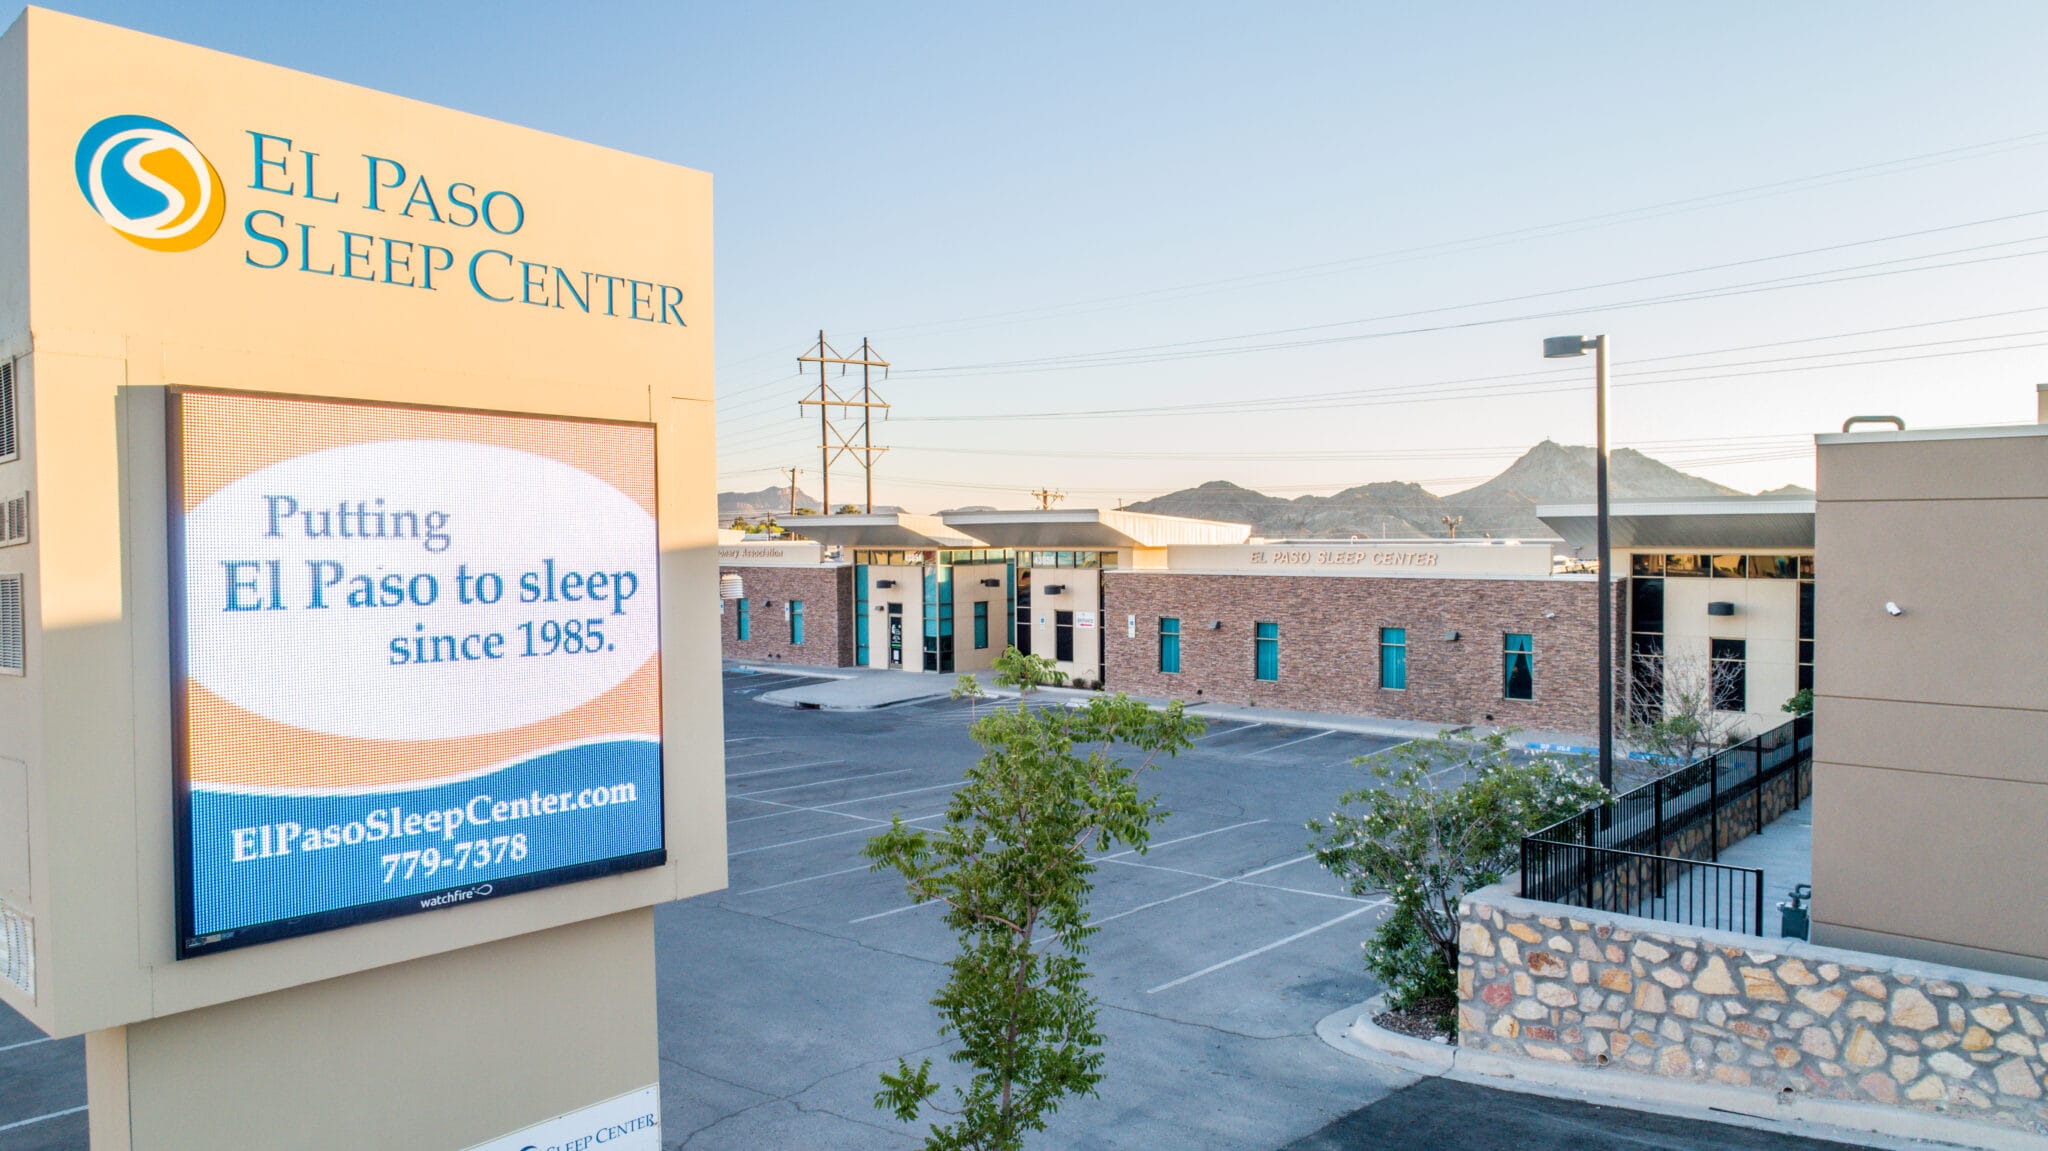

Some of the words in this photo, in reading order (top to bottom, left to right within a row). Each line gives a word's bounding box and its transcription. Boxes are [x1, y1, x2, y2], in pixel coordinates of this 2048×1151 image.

[245, 130, 340, 204] EL
[362, 153, 525, 235] PASO
[244, 209, 454, 291] SLEEP
[469, 249, 688, 327] CENTER
[262, 494, 450, 553] Putting
[221, 559, 288, 612] El
[305, 559, 439, 609] Paso
[455, 564, 504, 604] to
[519, 558, 638, 615] sleep
[1250, 551, 1268, 564] EL
[1273, 551, 1311, 564] PASO
[1317, 551, 1366, 565] SLEEP
[1372, 552, 1439, 566] CENTER
[389, 623, 504, 665] since
[518, 618, 615, 657] 1985.
[231, 781, 637, 864] ElPasoSleepCenter.com
[380, 833, 528, 884] 779-7378
[420, 890, 474, 908] watchfire
